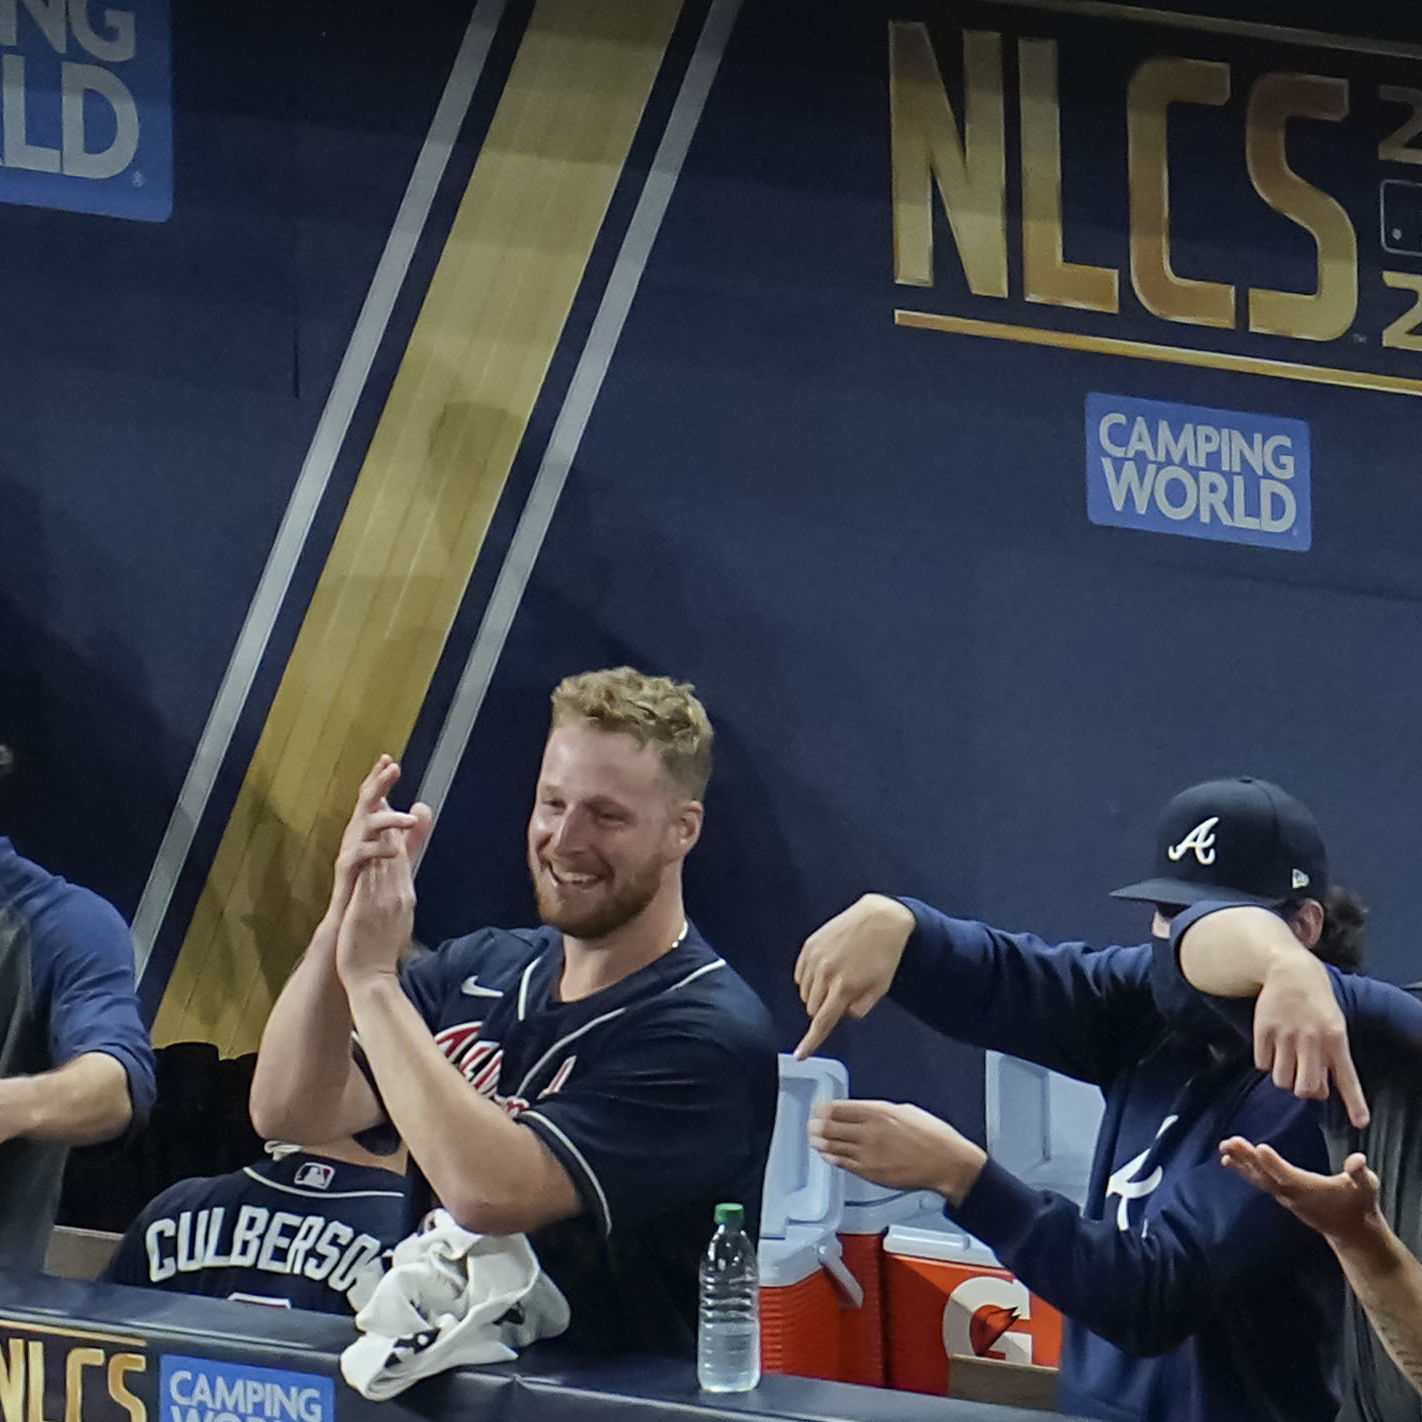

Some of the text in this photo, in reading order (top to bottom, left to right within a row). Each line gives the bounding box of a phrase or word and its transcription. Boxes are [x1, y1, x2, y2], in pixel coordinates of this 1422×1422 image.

[889, 20, 1358, 342] NLCS
[1098, 413, 1296, 480] CAMPING
[1100, 458, 1297, 534] WORLD
[1168, 817, 1219, 865] A
[146, 1205, 391, 1292] CULBERSO
